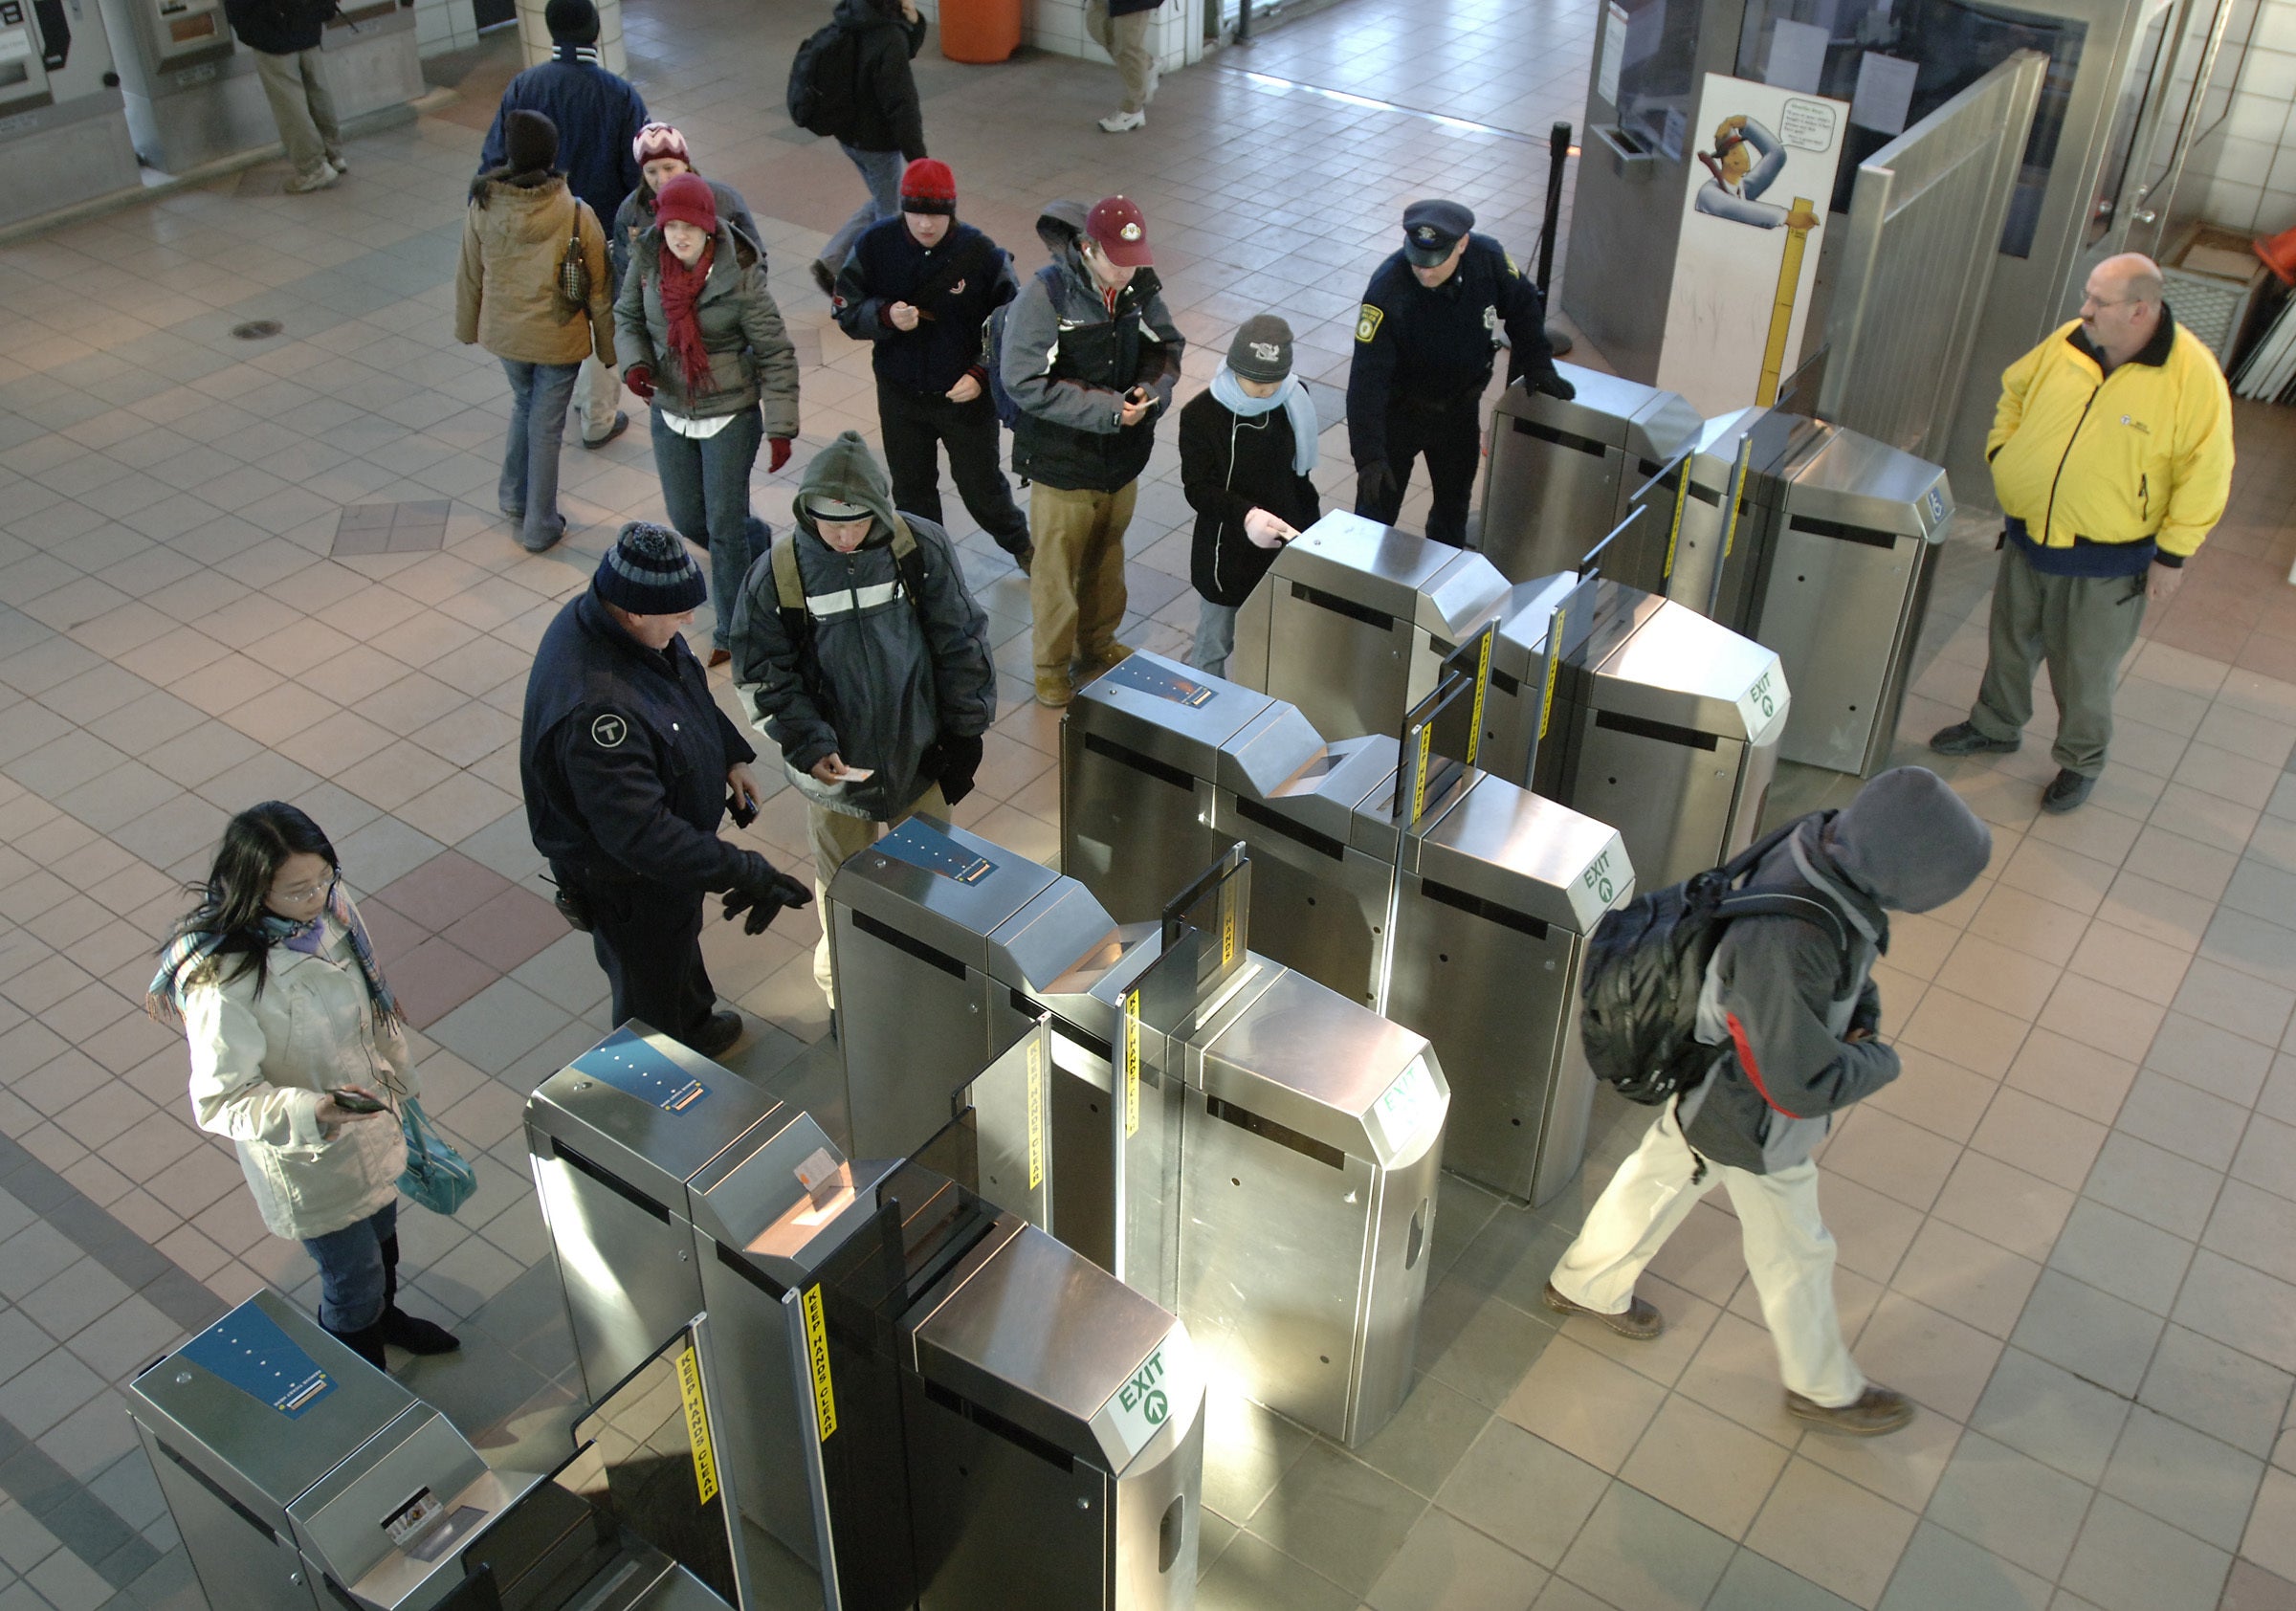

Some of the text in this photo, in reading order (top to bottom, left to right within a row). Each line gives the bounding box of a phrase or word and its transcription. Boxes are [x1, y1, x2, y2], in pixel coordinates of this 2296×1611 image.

[1750, 672, 1771, 703] EXIT
[1583, 850, 1609, 889] EXIT
[1382, 1067, 1414, 1112] EXIT
[808, 1291, 832, 1434] KEEP HANDS CLEAR
[1118, 1352, 1164, 1413] EXIT
[681, 1353, 714, 1497] KEEP HANDS CLEAR
